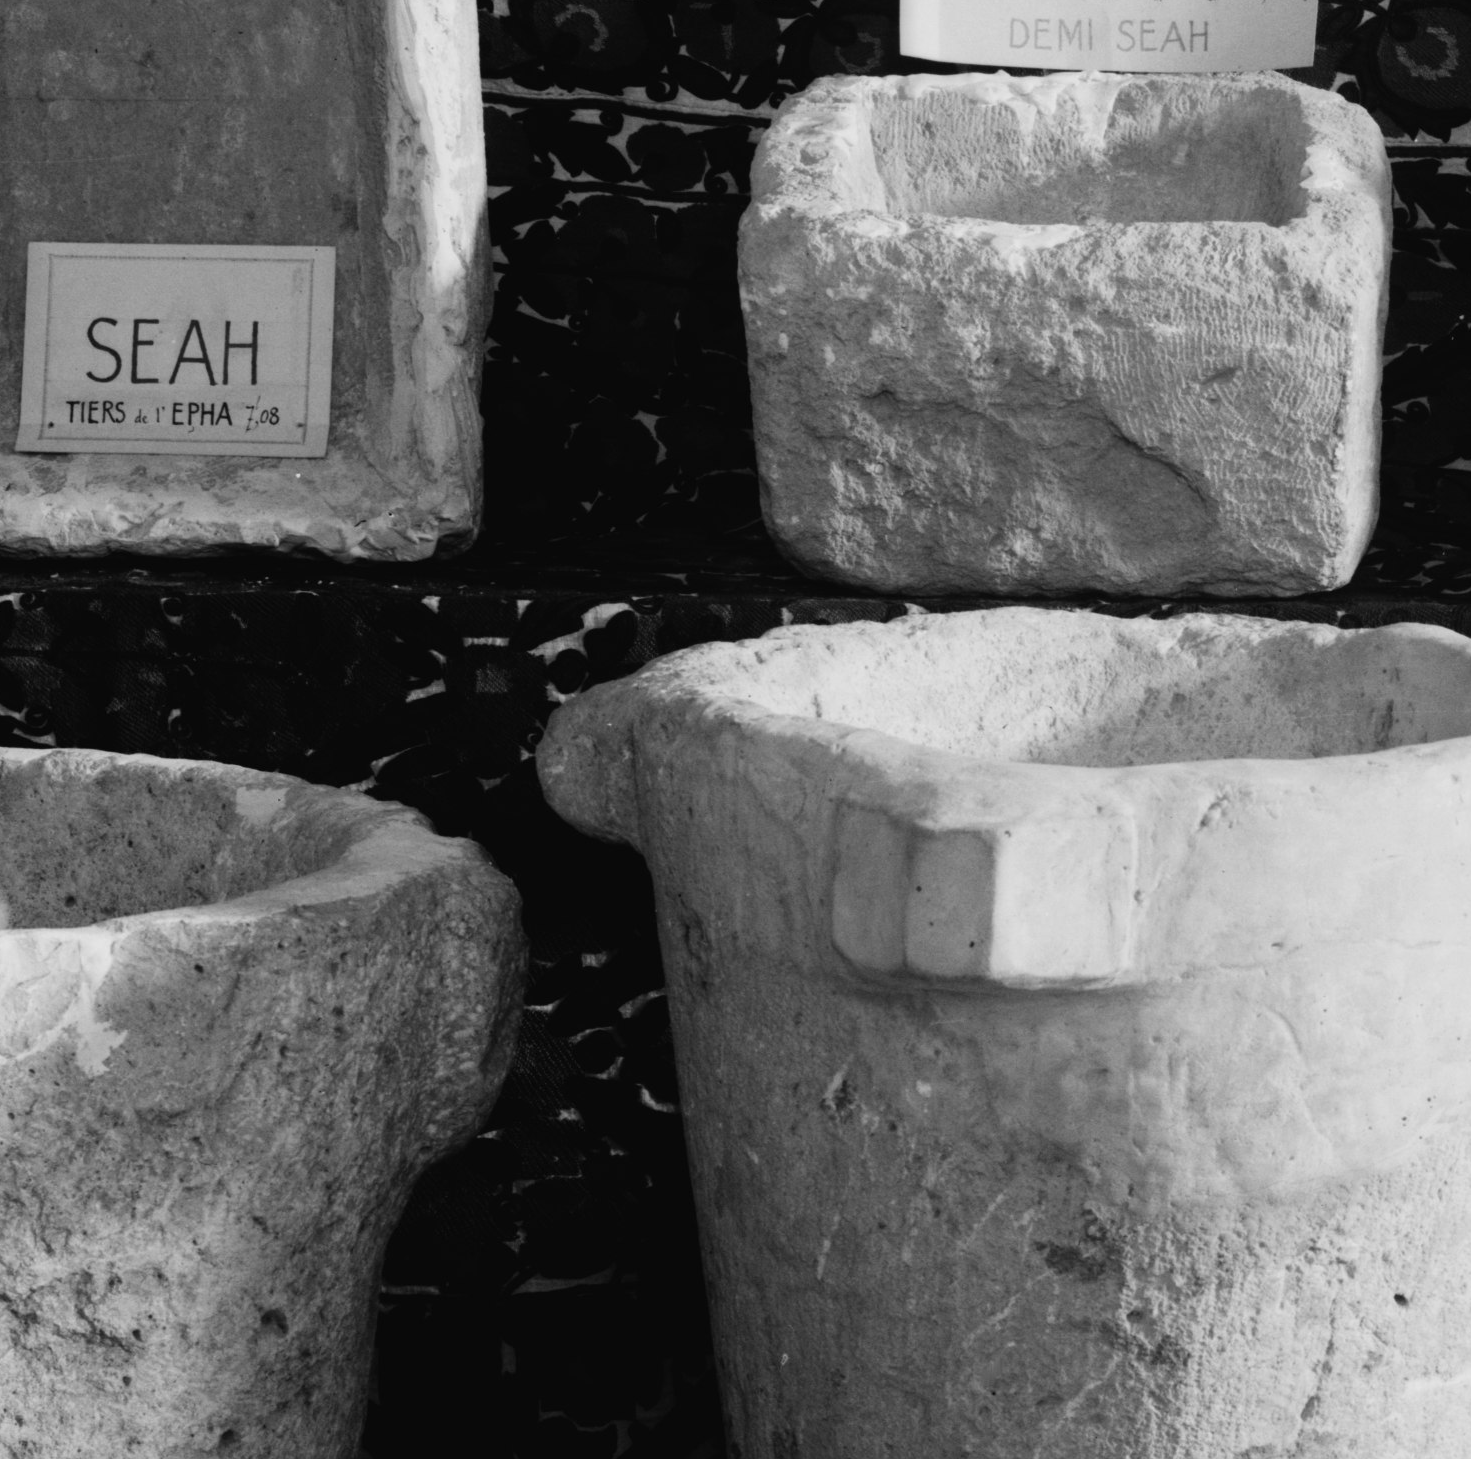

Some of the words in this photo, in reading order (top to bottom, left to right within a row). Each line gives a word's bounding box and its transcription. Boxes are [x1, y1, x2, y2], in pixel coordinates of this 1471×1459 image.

[1009, 17, 1094, 51] DEMI
[1116, 20, 1209, 53] SEAH
[87, 317, 258, 386] SEAH
[66, 401, 125, 424] TIERS
[135, 409, 147, 424] de
